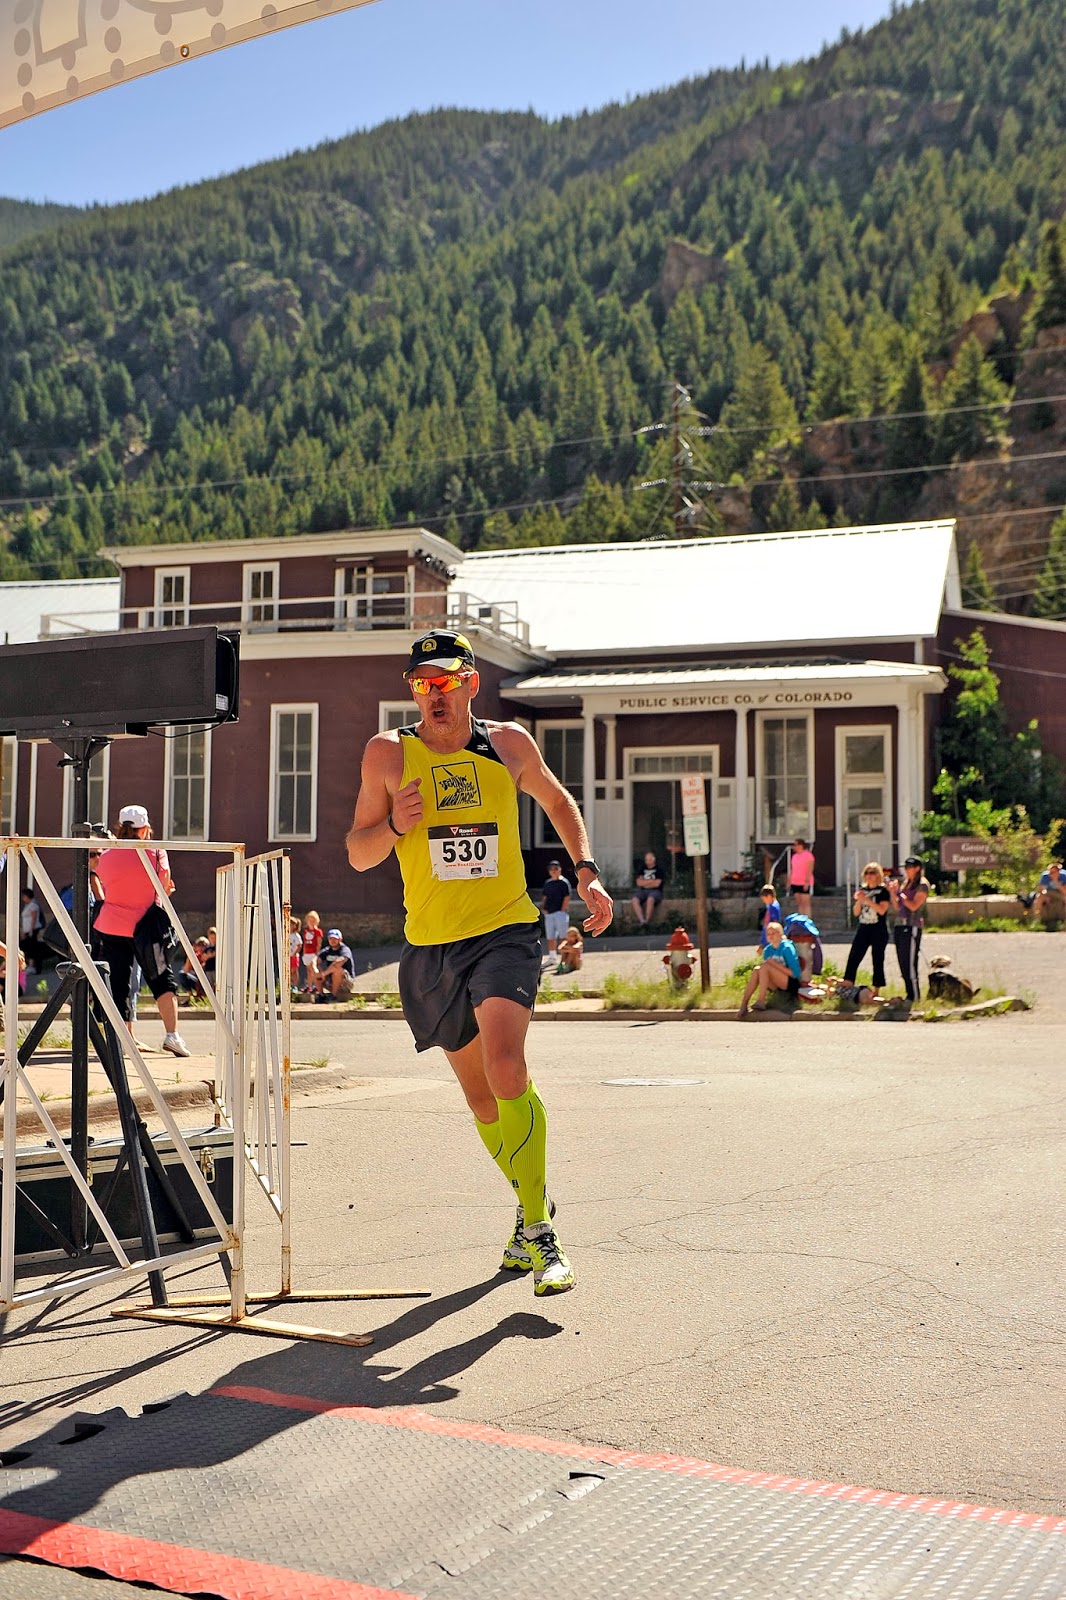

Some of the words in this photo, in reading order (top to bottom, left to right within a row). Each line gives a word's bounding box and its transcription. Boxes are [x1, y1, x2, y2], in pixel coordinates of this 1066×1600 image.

[620, 698, 667, 708] PUBLIC
[672, 695, 729, 707] SERVICE
[734, 695, 754, 704] CO.
[775, 692, 853, 702] COLORADO
[442, 838, 487, 863] 530
[952, 854, 987, 864] Energy
